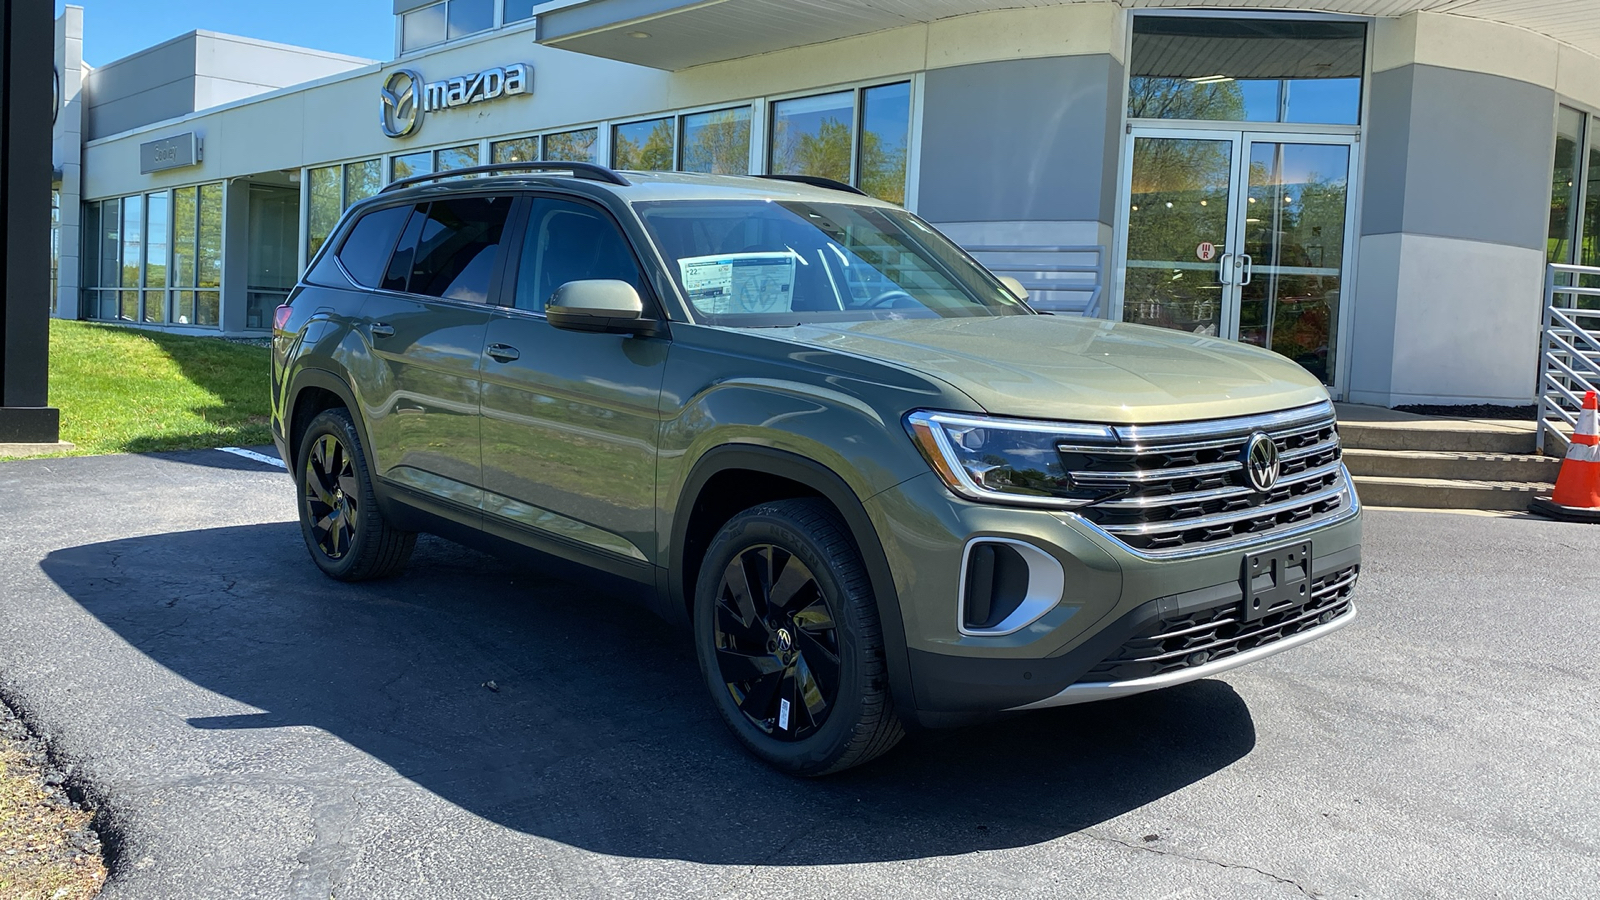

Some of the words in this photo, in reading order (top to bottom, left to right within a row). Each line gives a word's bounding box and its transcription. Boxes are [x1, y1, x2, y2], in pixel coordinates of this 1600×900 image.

[1203, 251, 1209, 259] R
[689, 268, 698, 276] 22
[769, 525, 820, 568] NEXEN
